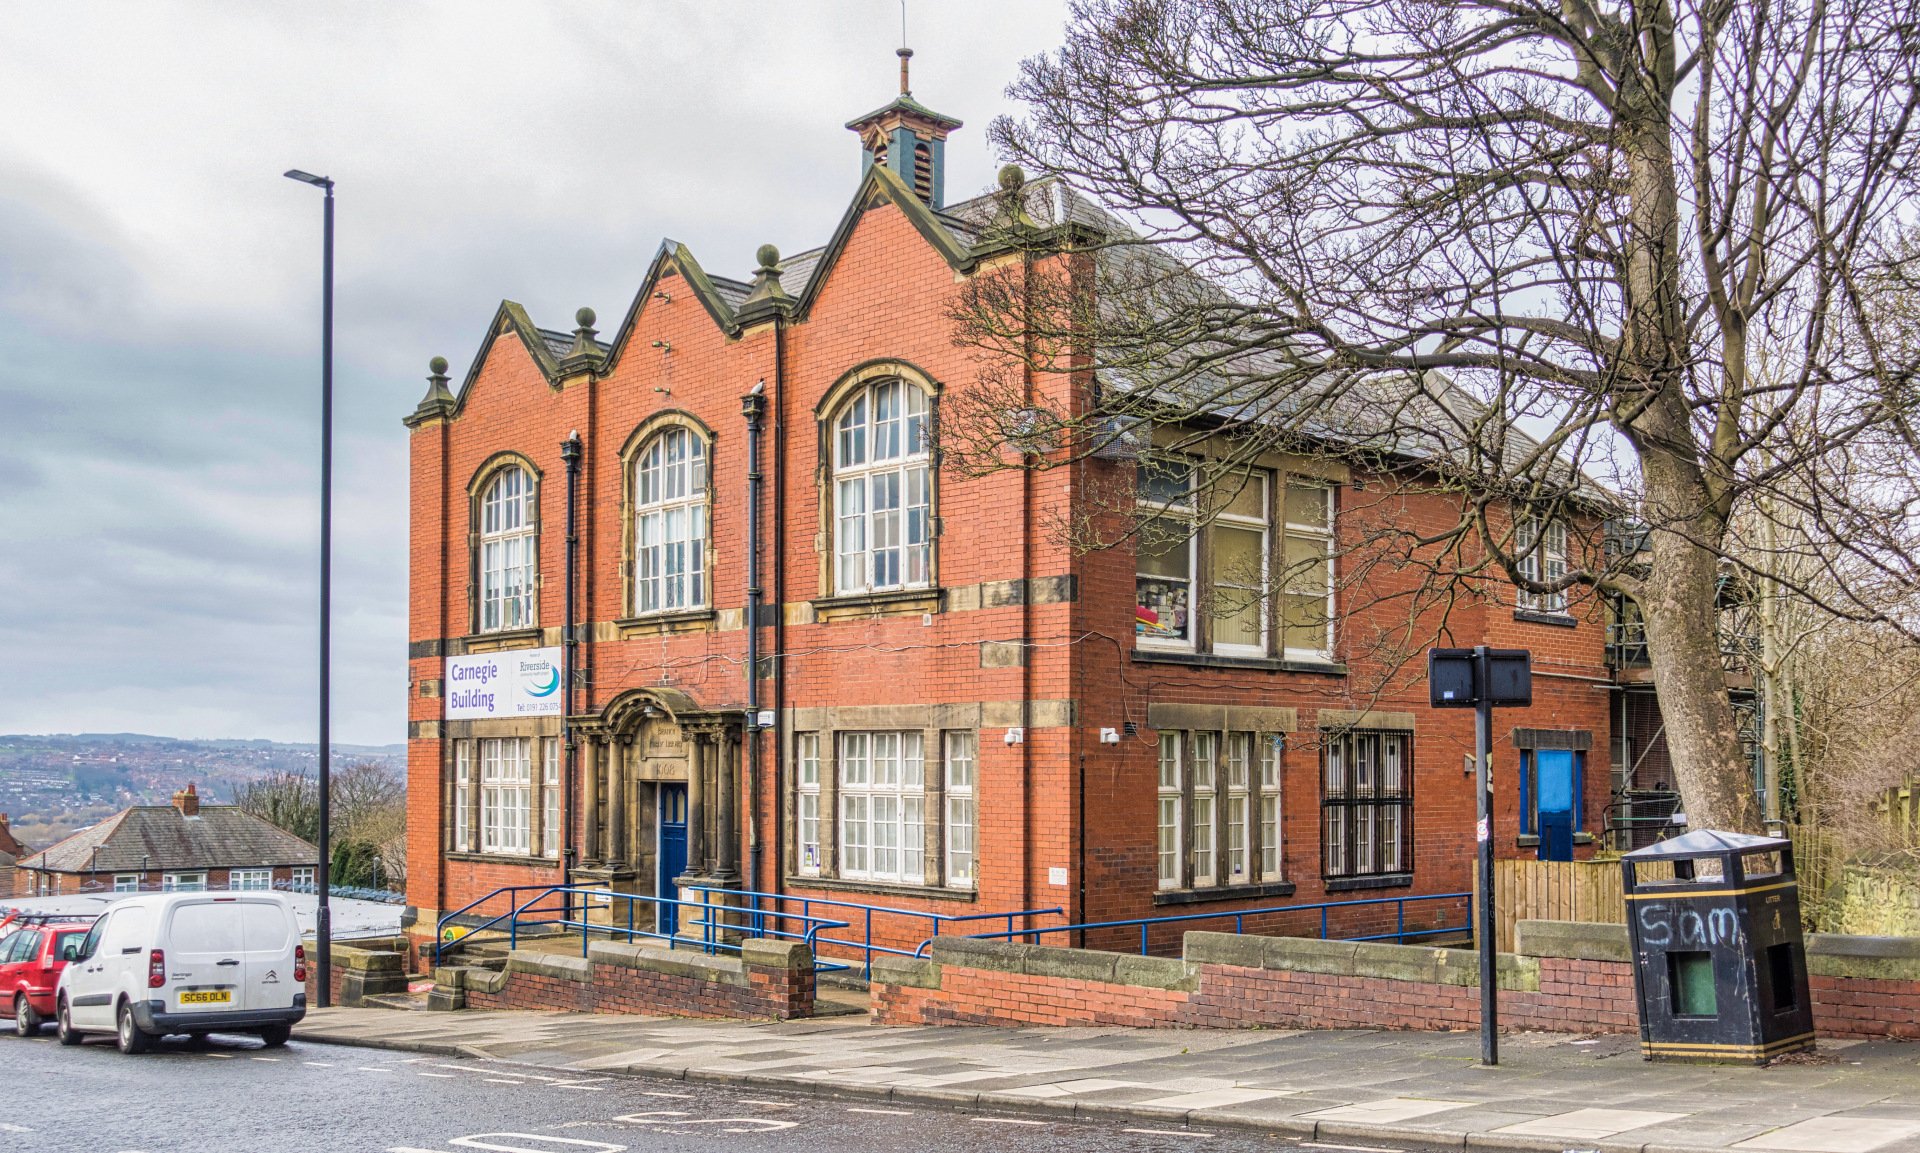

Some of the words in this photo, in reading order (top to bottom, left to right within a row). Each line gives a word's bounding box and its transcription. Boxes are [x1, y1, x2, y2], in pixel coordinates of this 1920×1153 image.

[520, 659, 550, 672] Riverside
[451, 660, 498, 684] Carnegie
[451, 688, 495, 712] Building
[539, 703, 549, 711] 226
[1765, 895, 1781, 904] LITTER
[184, 992, 208, 1002] SC66
[209, 991, 227, 1001] OLN
